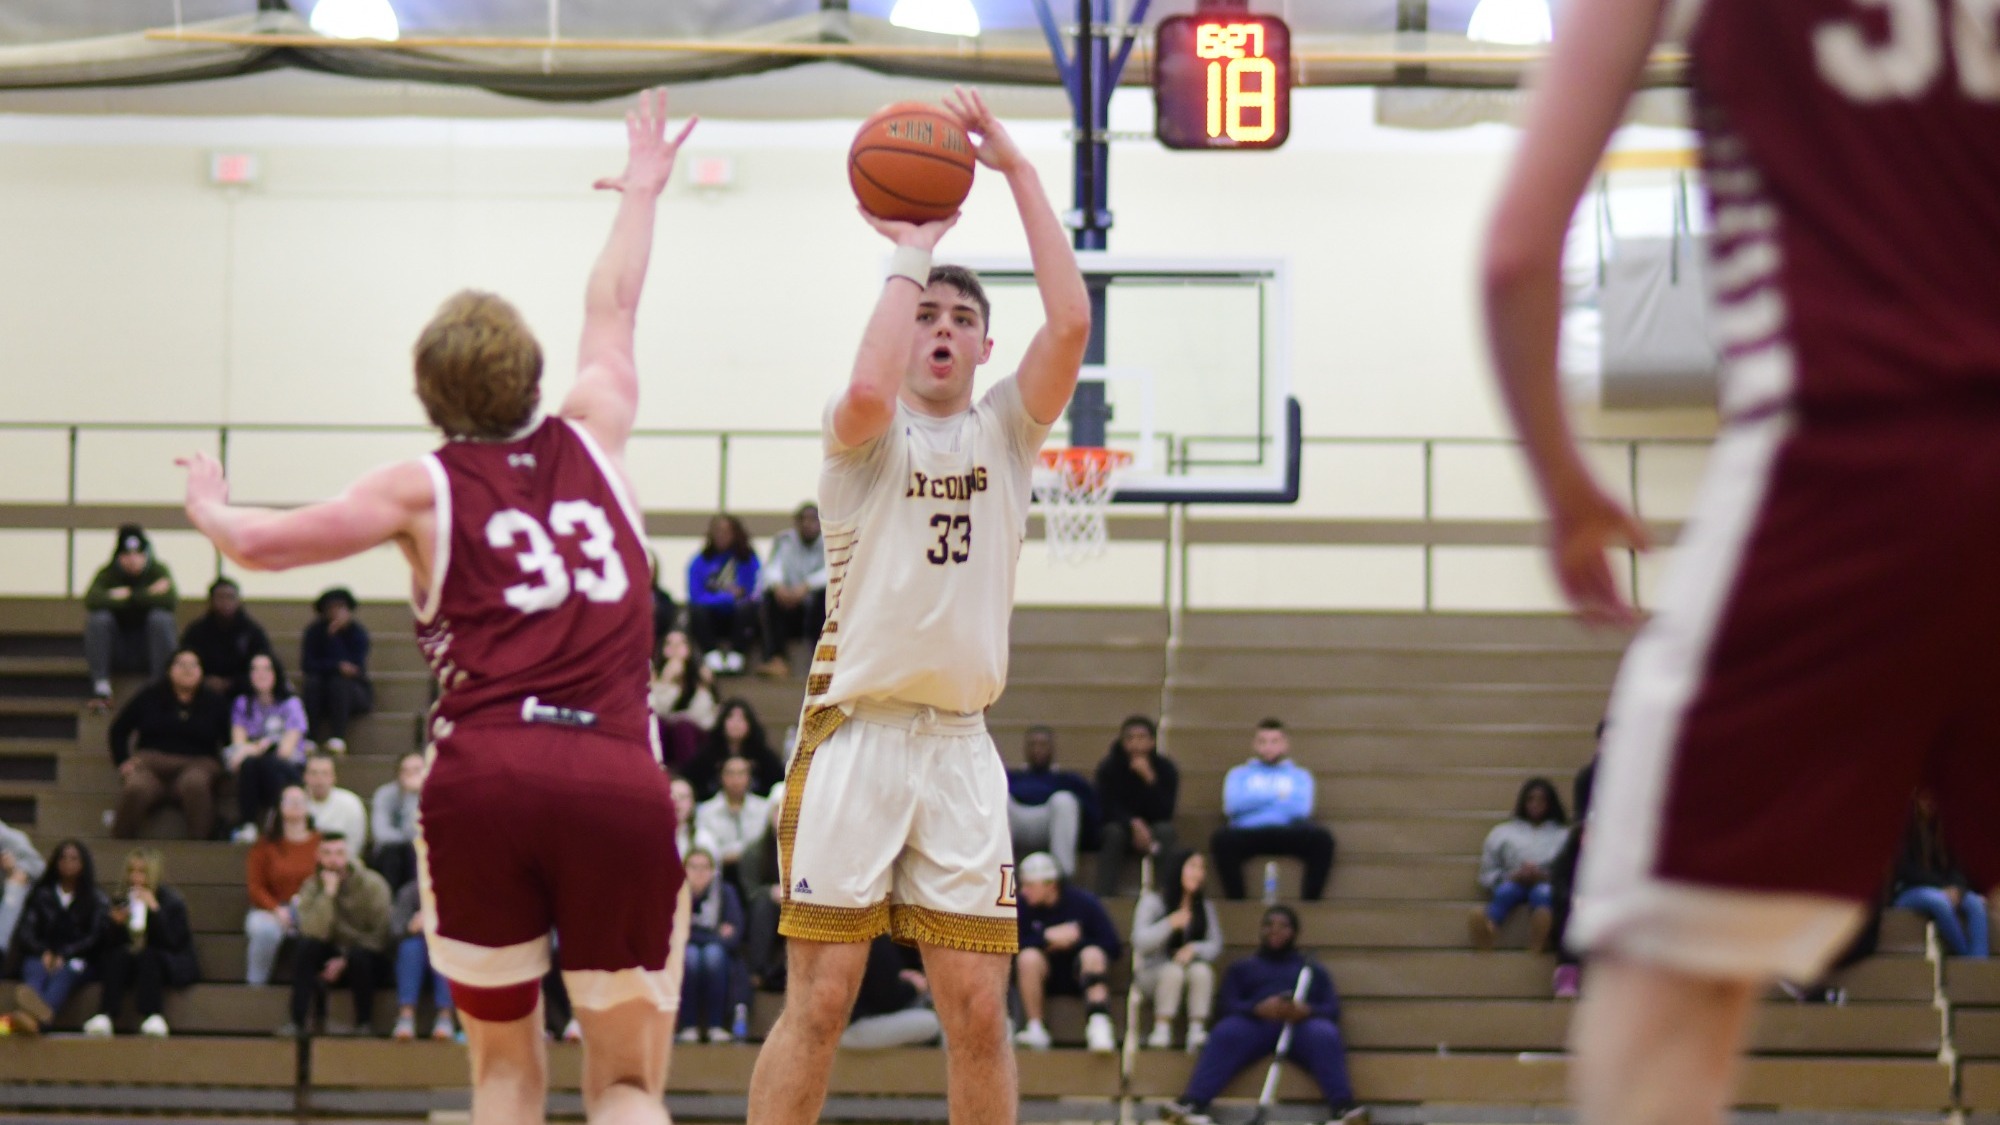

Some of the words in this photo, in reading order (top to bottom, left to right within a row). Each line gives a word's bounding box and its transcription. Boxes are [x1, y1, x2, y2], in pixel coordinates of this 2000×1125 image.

[1811, 0, 2000, 102] 3
[1207, 57, 1275, 142] 18
[906, 466, 988, 501] YCONG
[486, 499, 629, 614] 33
[927, 514, 972, 565] 33
